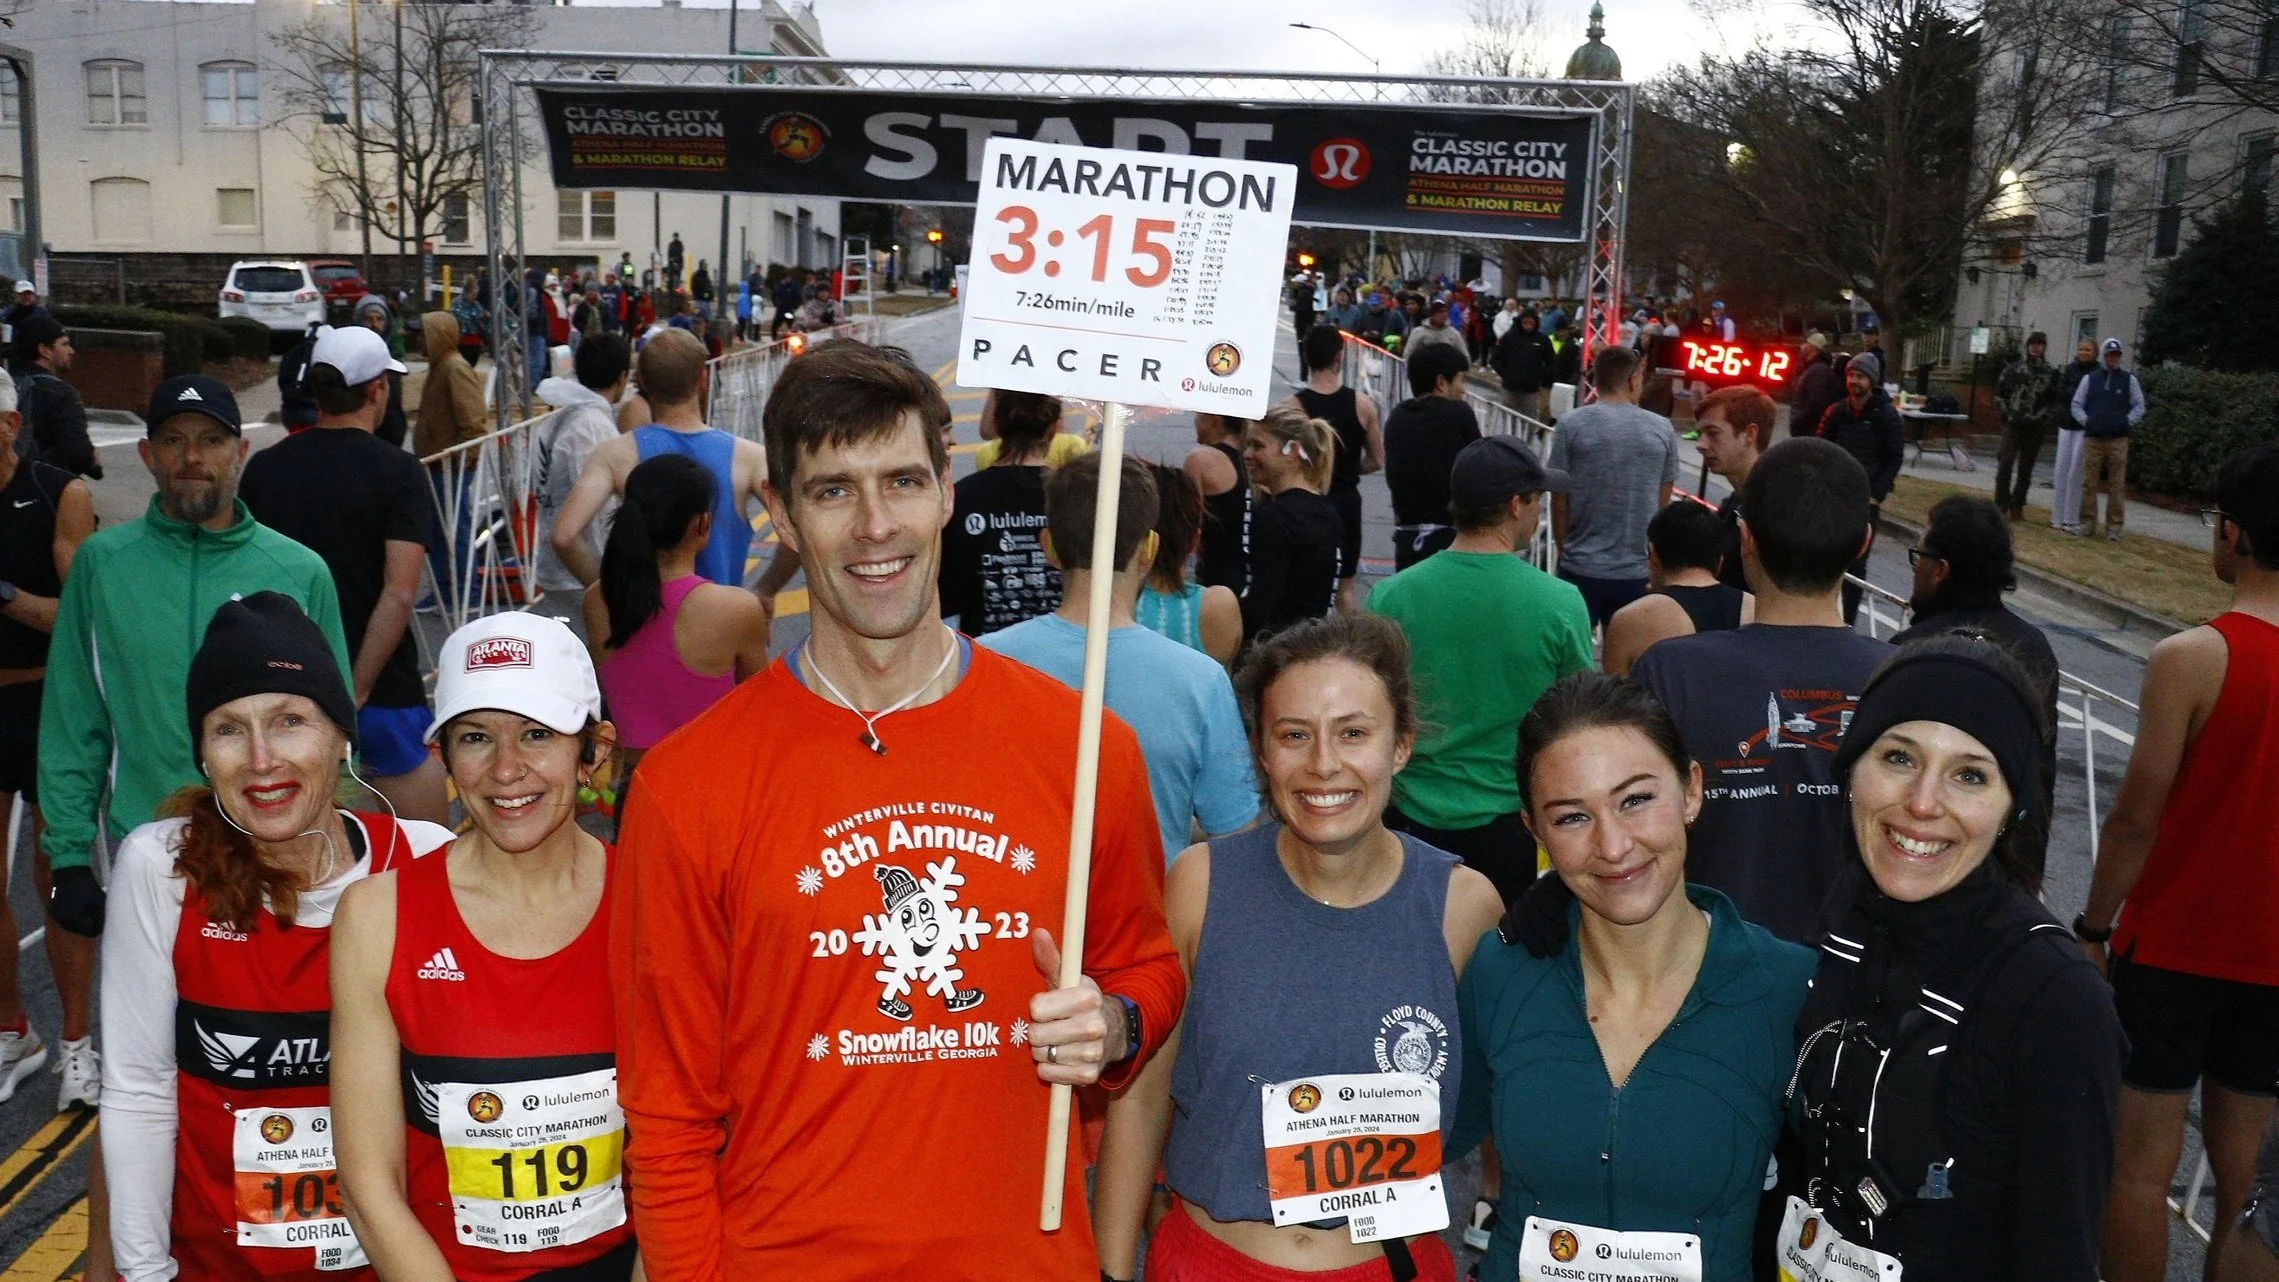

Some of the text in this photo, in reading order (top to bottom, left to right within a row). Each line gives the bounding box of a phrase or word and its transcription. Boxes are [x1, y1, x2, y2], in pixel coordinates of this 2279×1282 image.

[564, 106, 719, 123] CLASSIC CITY
[566, 120, 724, 137] MARATHON
[1412, 138, 1567, 158] CLASSIC CITY
[587, 154, 674, 165] MARATHON
[679, 155, 726, 167] RELAY
[1409, 155, 1567, 180] MARATHON
[995, 153, 1276, 213] MARATHON
[1408, 178, 1565, 196] ATHENA HALF MARATHON
[1406, 194, 1562, 214] & MARATHON RELAY
[990, 205, 1177, 288] 3:15
[972, 338, 1163, 382] PACER
[1199, 381, 1253, 397] lululemon
[473, 641, 526, 656] ATLANTA
[1780, 688, 1843, 700] COLUMBUS
[1730, 785, 1778, 799] ANNUAL
[823, 802, 995, 839] WINTERVILLE CIVITAN
[821, 820, 1009, 879] 8th Annual
[201, 926, 248, 942] adidas
[995, 912, 1030, 939] 23
[809, 929, 848, 958] 20
[417, 967, 465, 982] adidas
[1381, 1005, 1448, 1037] FLOYD COUNTY
[838, 1024, 959, 1056] Snowflake
[841, 1047, 998, 1067] WINTERVILLE GEORGIA
[1374, 1037, 1393, 1073] COLLEGE
[267, 1064, 324, 1077] TRAC
[544, 1088, 610, 1106] lululemon
[1359, 1087, 1422, 1099] lululemon
[465, 1114, 608, 1139] CLASSIC CITY MARATHON
[1286, 1113, 1420, 1132] ATHENA HALF MARATHON
[1326, 1128, 1351, 1136] January
[509, 1140, 537, 1148] January
[257, 1147, 329, 1162] ATHENA HALF
[298, 1162, 324, 1170] January
[491, 1144, 588, 1199] 119
[1294, 1136, 1417, 1192] 1022
[501, 1197, 582, 1220] CORRAL A
[1320, 1187, 1397, 1213] CORRAL A
[477, 1225, 497, 1235] GEAR
[1354, 1216, 1375, 1228] FOOD
[286, 1223, 351, 1242] CORRAL
[476, 1233, 527, 1245] CHECK 119
[537, 1226, 560, 1237] FOOD
[541, 1235, 558, 1245] 119
[1355, 1227, 1377, 1238] 1022
[321, 1248, 342, 1258] FOOD
[1616, 1248, 1682, 1261] lululemon
[321, 1258, 341, 1268] 1034
[1540, 1264, 1585, 1281] CLASSIC
[1588, 1272, 1613, 1282] CITY
